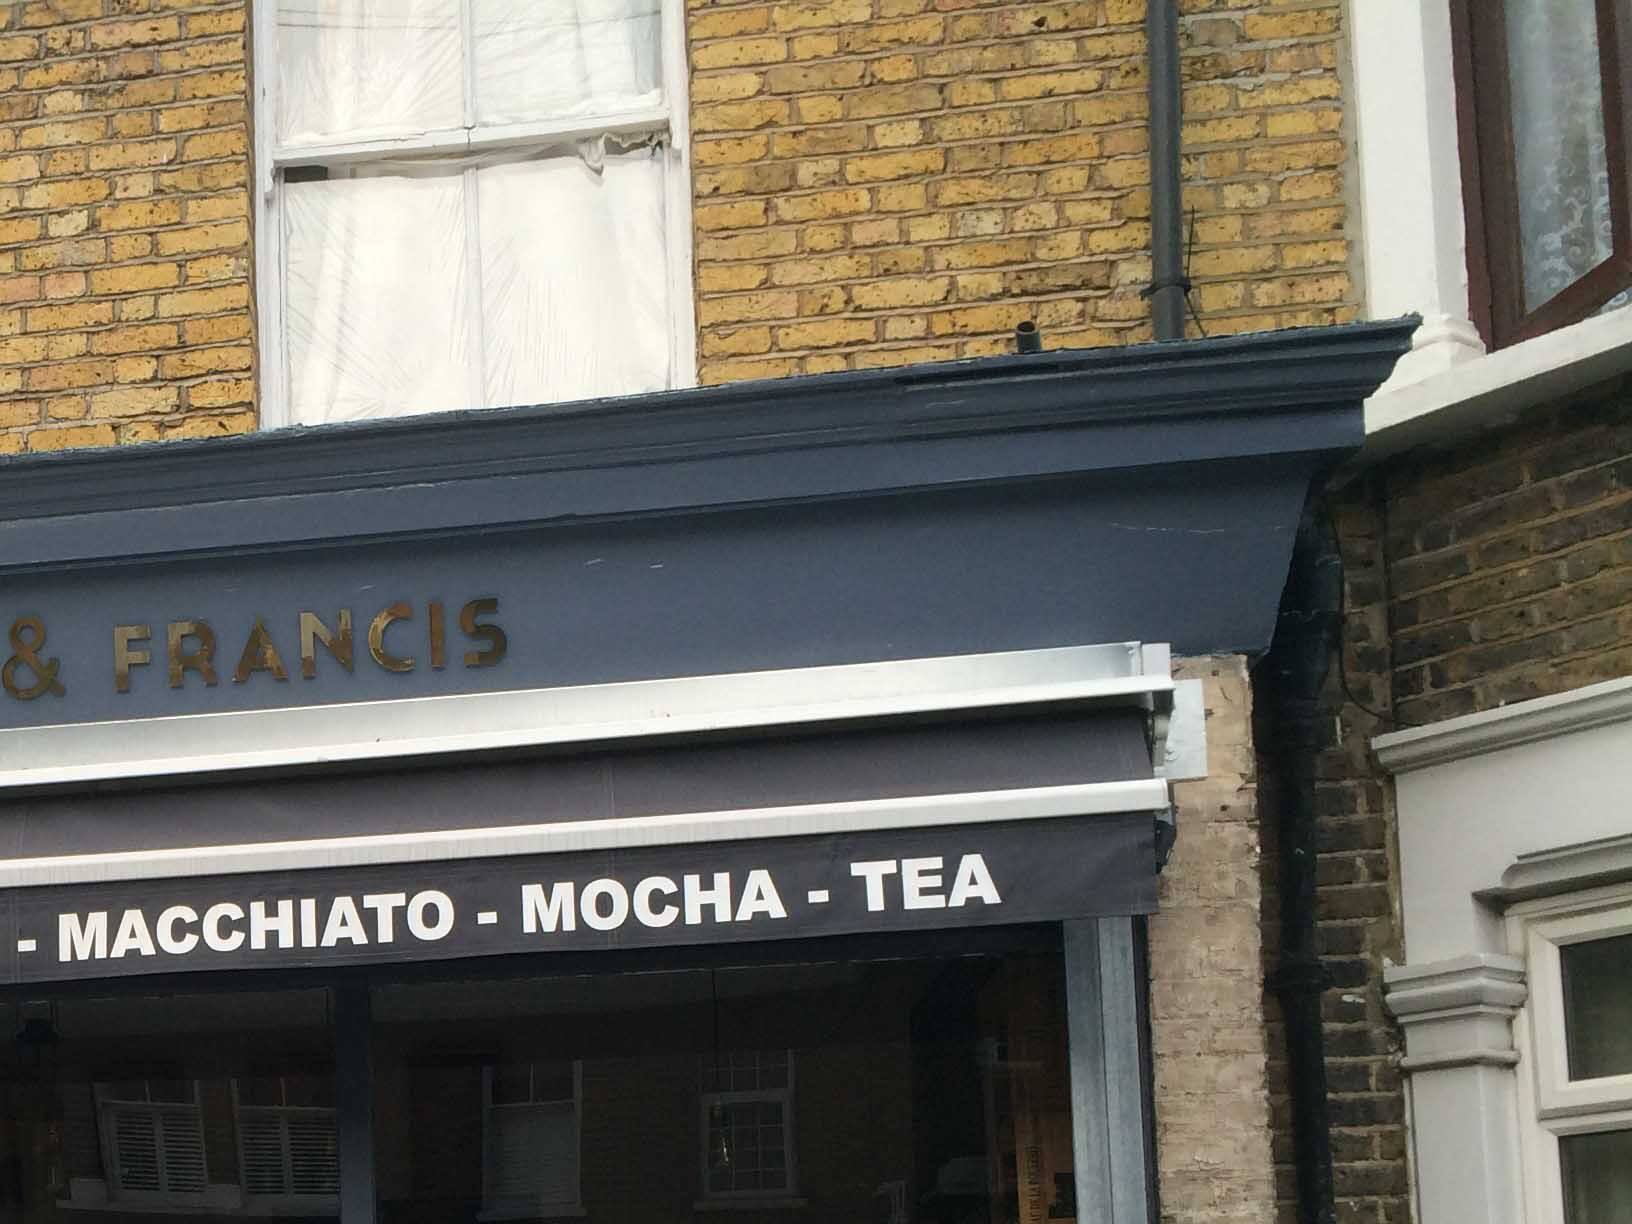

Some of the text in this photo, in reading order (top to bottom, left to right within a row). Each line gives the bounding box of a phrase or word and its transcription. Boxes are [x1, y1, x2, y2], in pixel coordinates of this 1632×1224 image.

[1, 618, 66, 700] &
[113, 597, 508, 693] FRANCIS
[58, 889, 455, 962] MACCHIATO
[521, 869, 788, 934] MOCHA
[850, 853, 1002, 912] TEA
